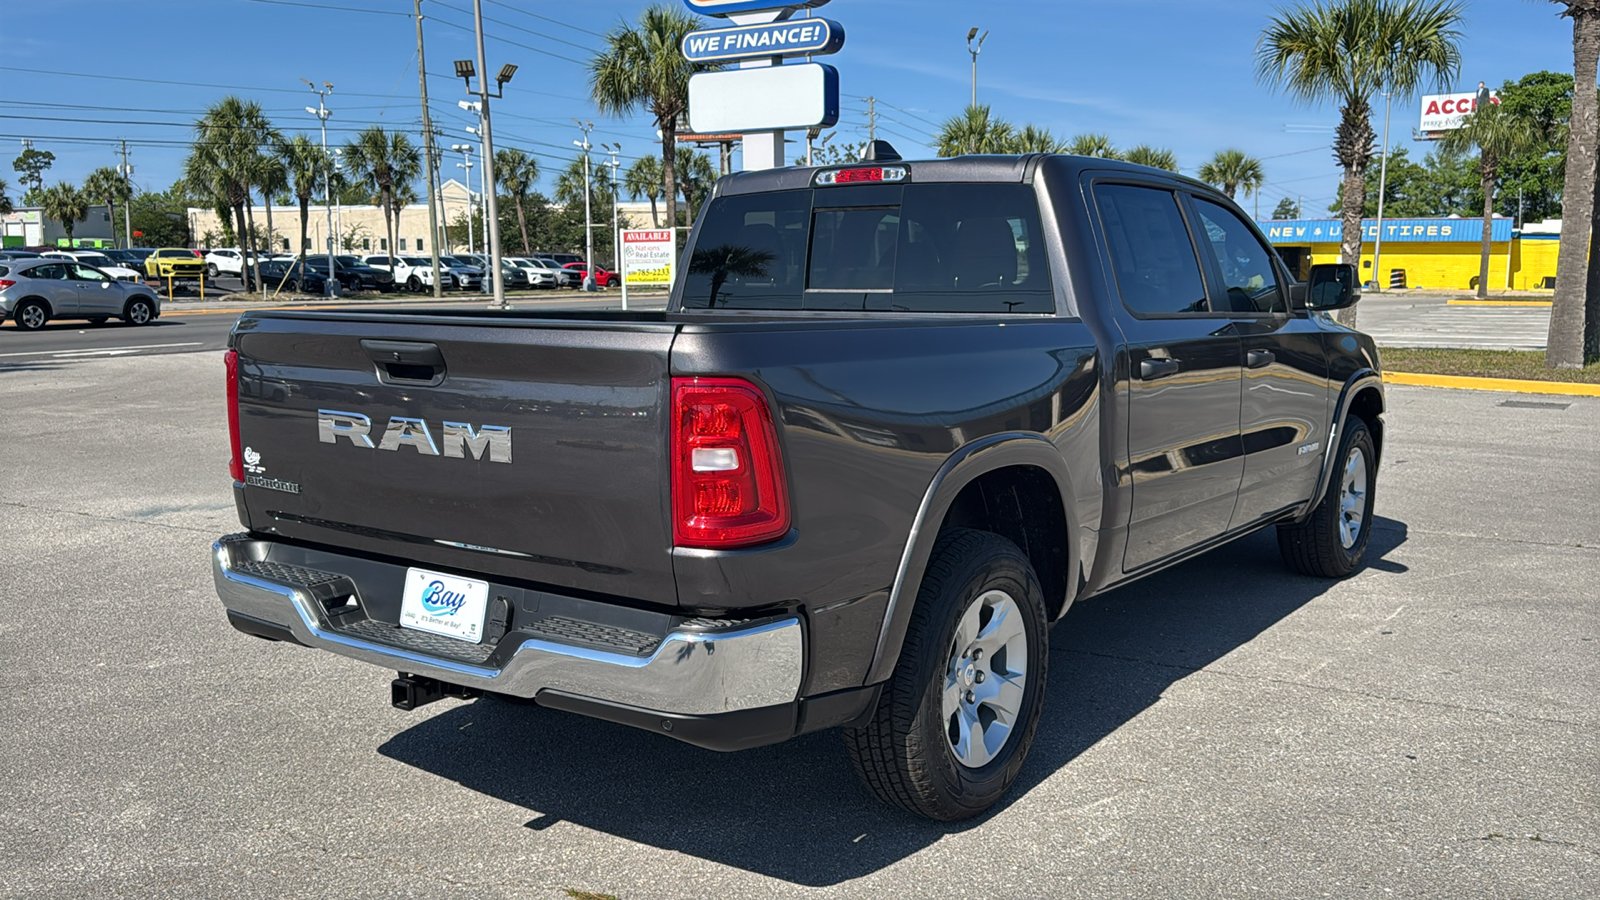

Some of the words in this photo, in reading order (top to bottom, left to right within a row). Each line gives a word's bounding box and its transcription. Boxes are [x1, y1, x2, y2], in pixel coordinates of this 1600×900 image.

[689, 36, 720, 53] WE
[723, 26, 820, 50] FINANCE!
[1269, 227, 1305, 236] NEW
[1387, 225, 1452, 236] TIRES
[626, 232, 669, 241] AVAILABLE
[637, 268, 669, 276] 785-2233
[318, 408, 512, 464] RAM
[425, 580, 466, 616] Bay
[428, 616, 444, 625] Better
